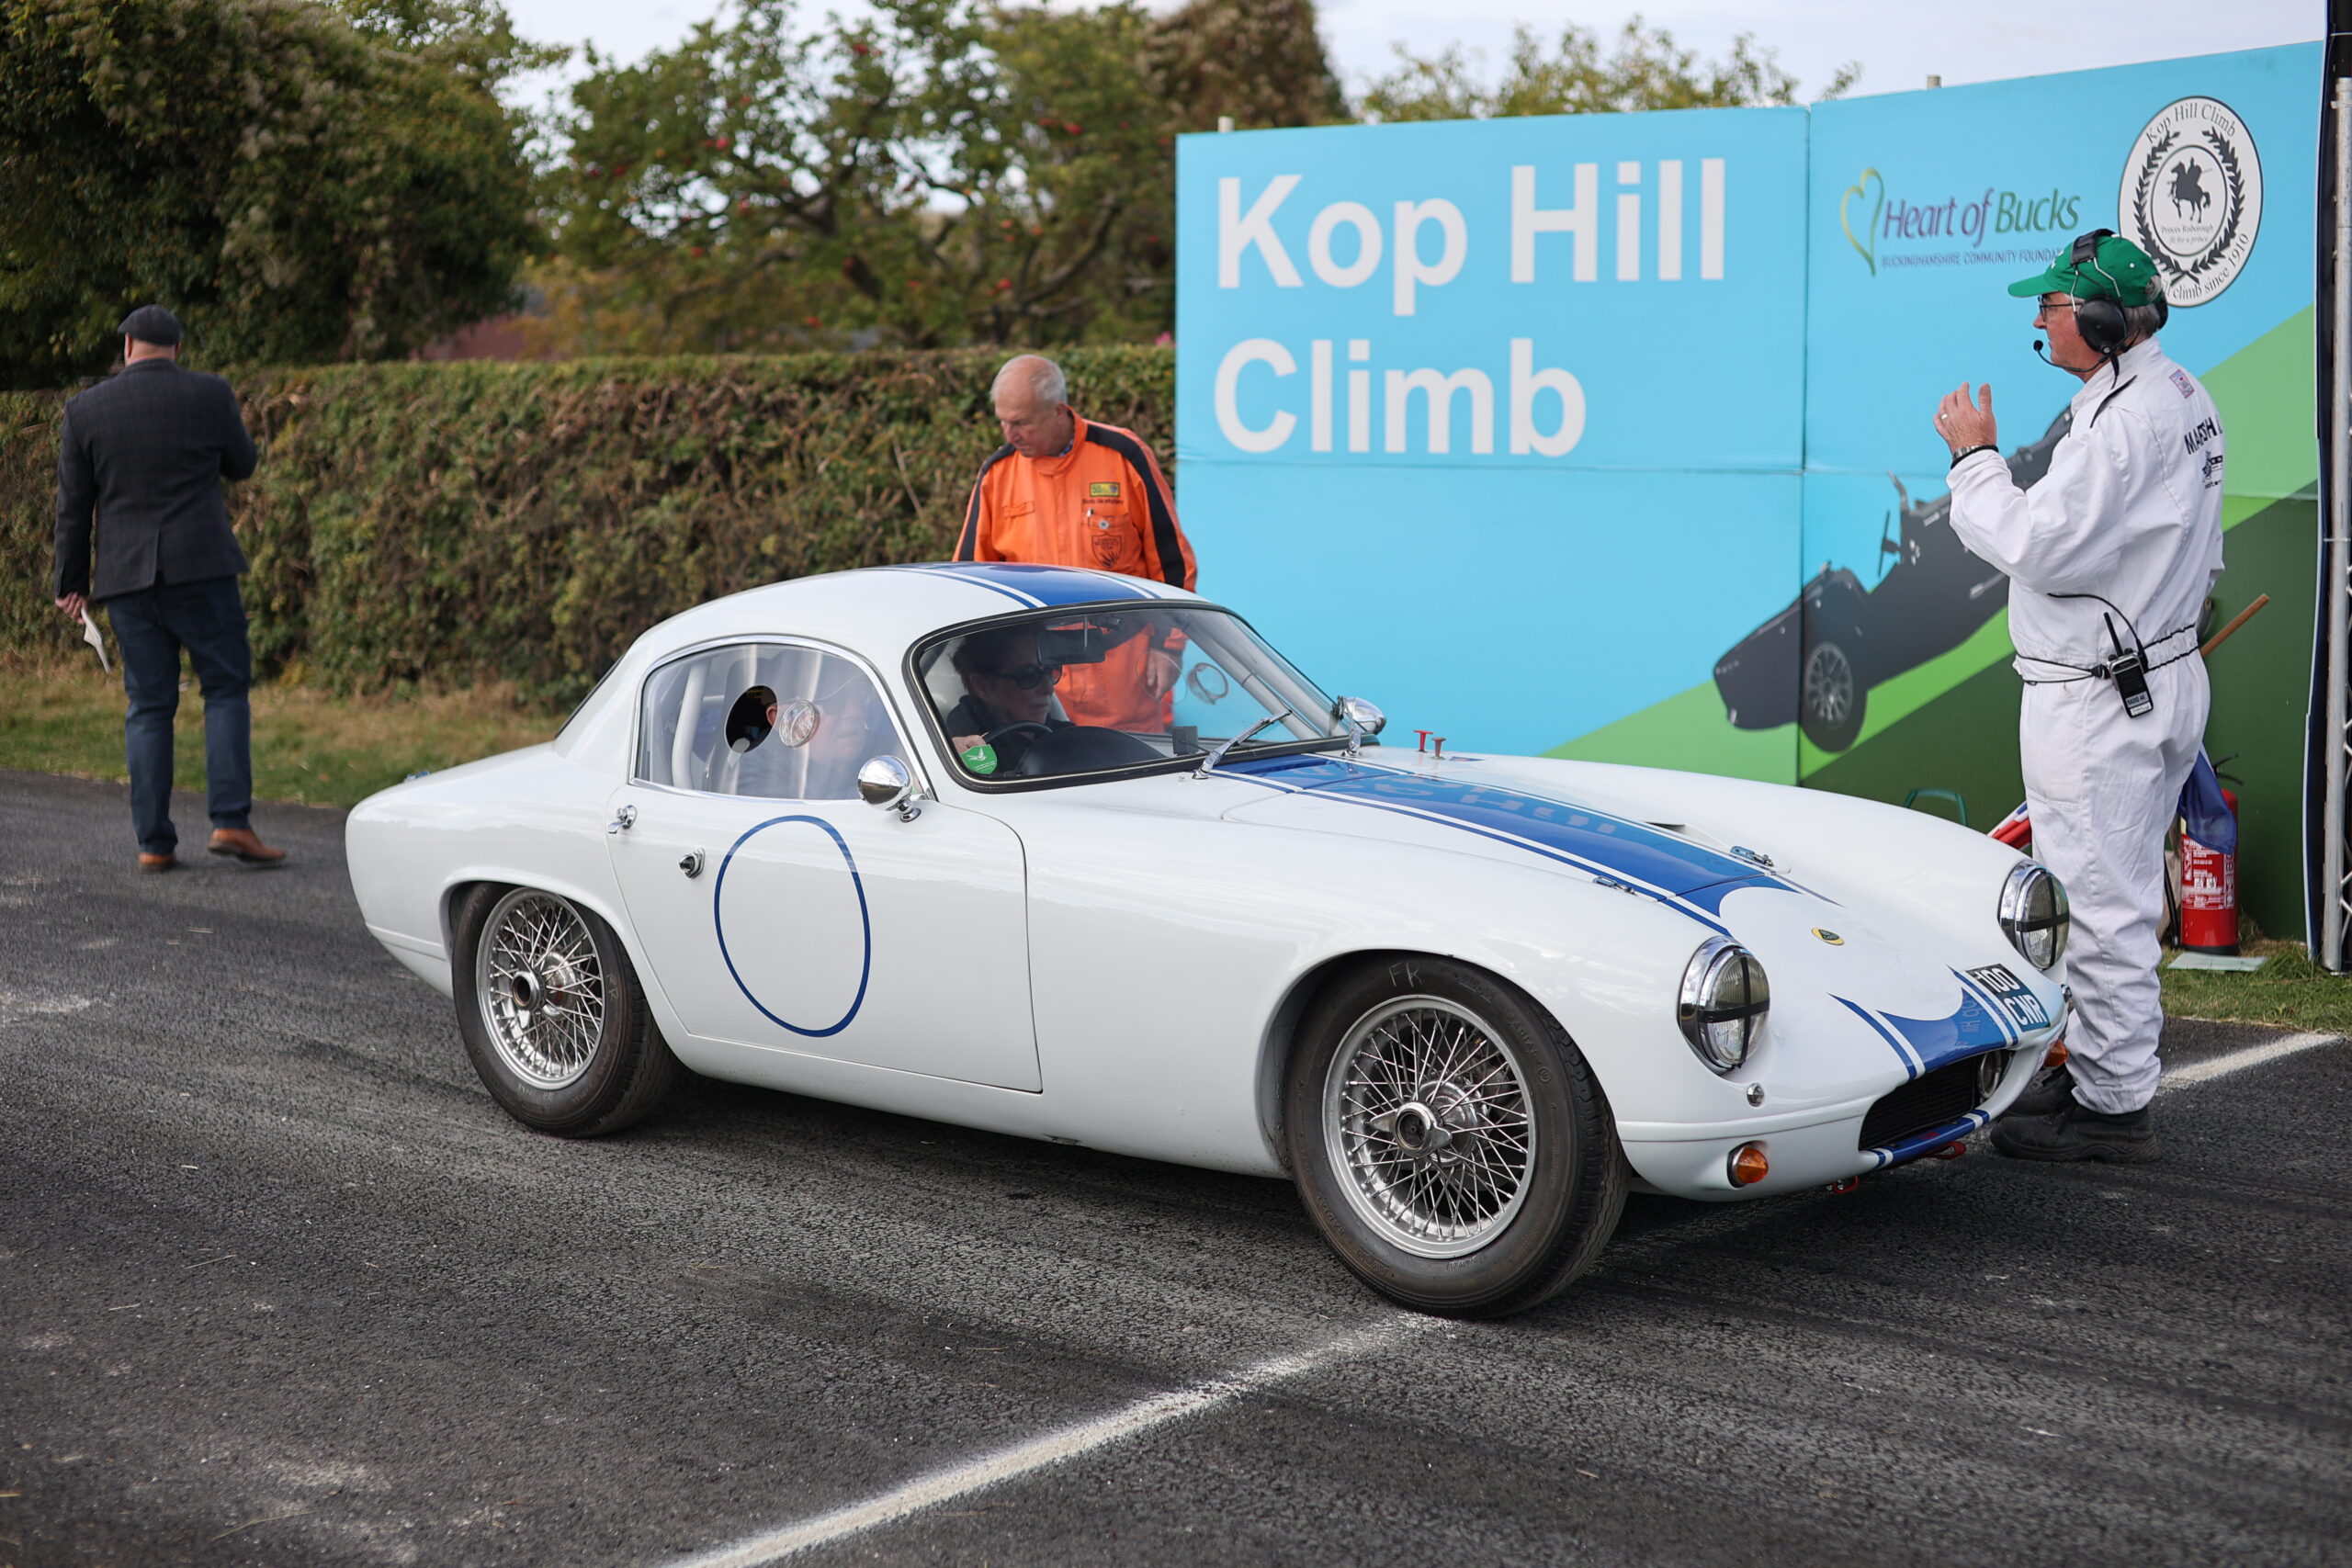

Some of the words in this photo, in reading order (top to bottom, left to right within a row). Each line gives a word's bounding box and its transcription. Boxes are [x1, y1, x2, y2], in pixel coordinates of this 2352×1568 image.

[2145, 117, 2171, 143] Kop
[2174, 102, 2198, 122] Hill
[2201, 103, 2236, 137] Climb
[1217, 174, 1468, 317] Kop
[1510, 157, 1726, 283] Hill
[1883, 196, 1958, 240] Heart
[1961, 186, 1996, 248] of
[1996, 188, 2081, 233] Bucks
[1882, 253, 1962, 268] BUCKINGHAMSHIRE
[1963, 249, 2017, 265] COMMUNITY
[2018, 247, 2064, 263] FOUNDA
[2173, 283, 2202, 300] climb
[2204, 266, 2231, 294] since
[2228, 232, 2250, 268] 1910
[1213, 337, 1587, 457] Climb
[1387, 960, 1423, 988] FR
[2003, 994, 2048, 1025] CNR
